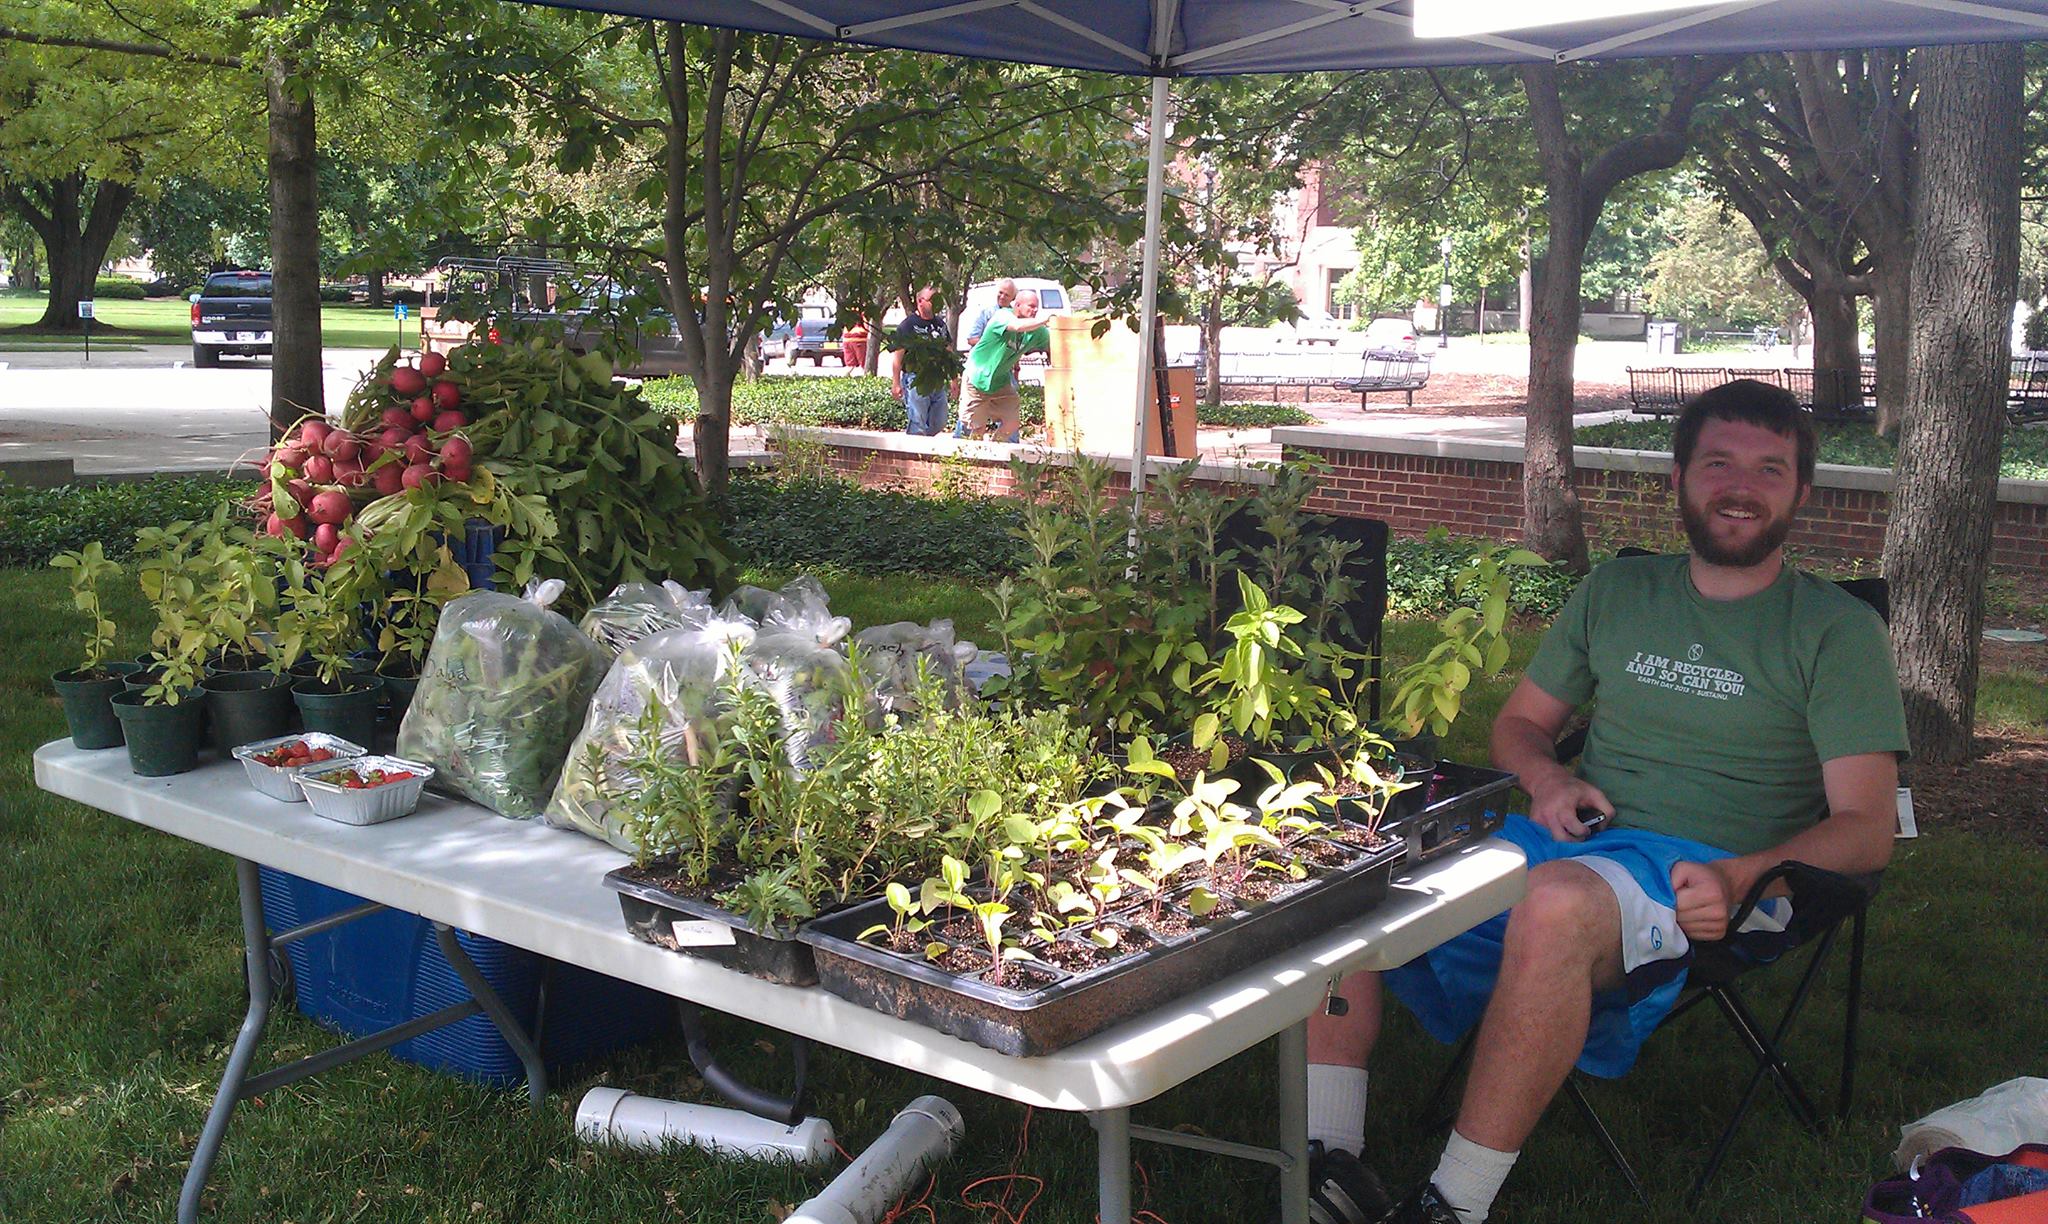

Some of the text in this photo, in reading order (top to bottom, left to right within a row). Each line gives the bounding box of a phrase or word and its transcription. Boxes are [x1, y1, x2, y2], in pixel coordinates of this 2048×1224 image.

[1625, 661, 1745, 696] AND SO CAN YOU!
[1634, 652, 1744, 683] I AM RECYCLED
[1637, 675, 1660, 686] EARTH
[1660, 681, 1674, 690] DAY
